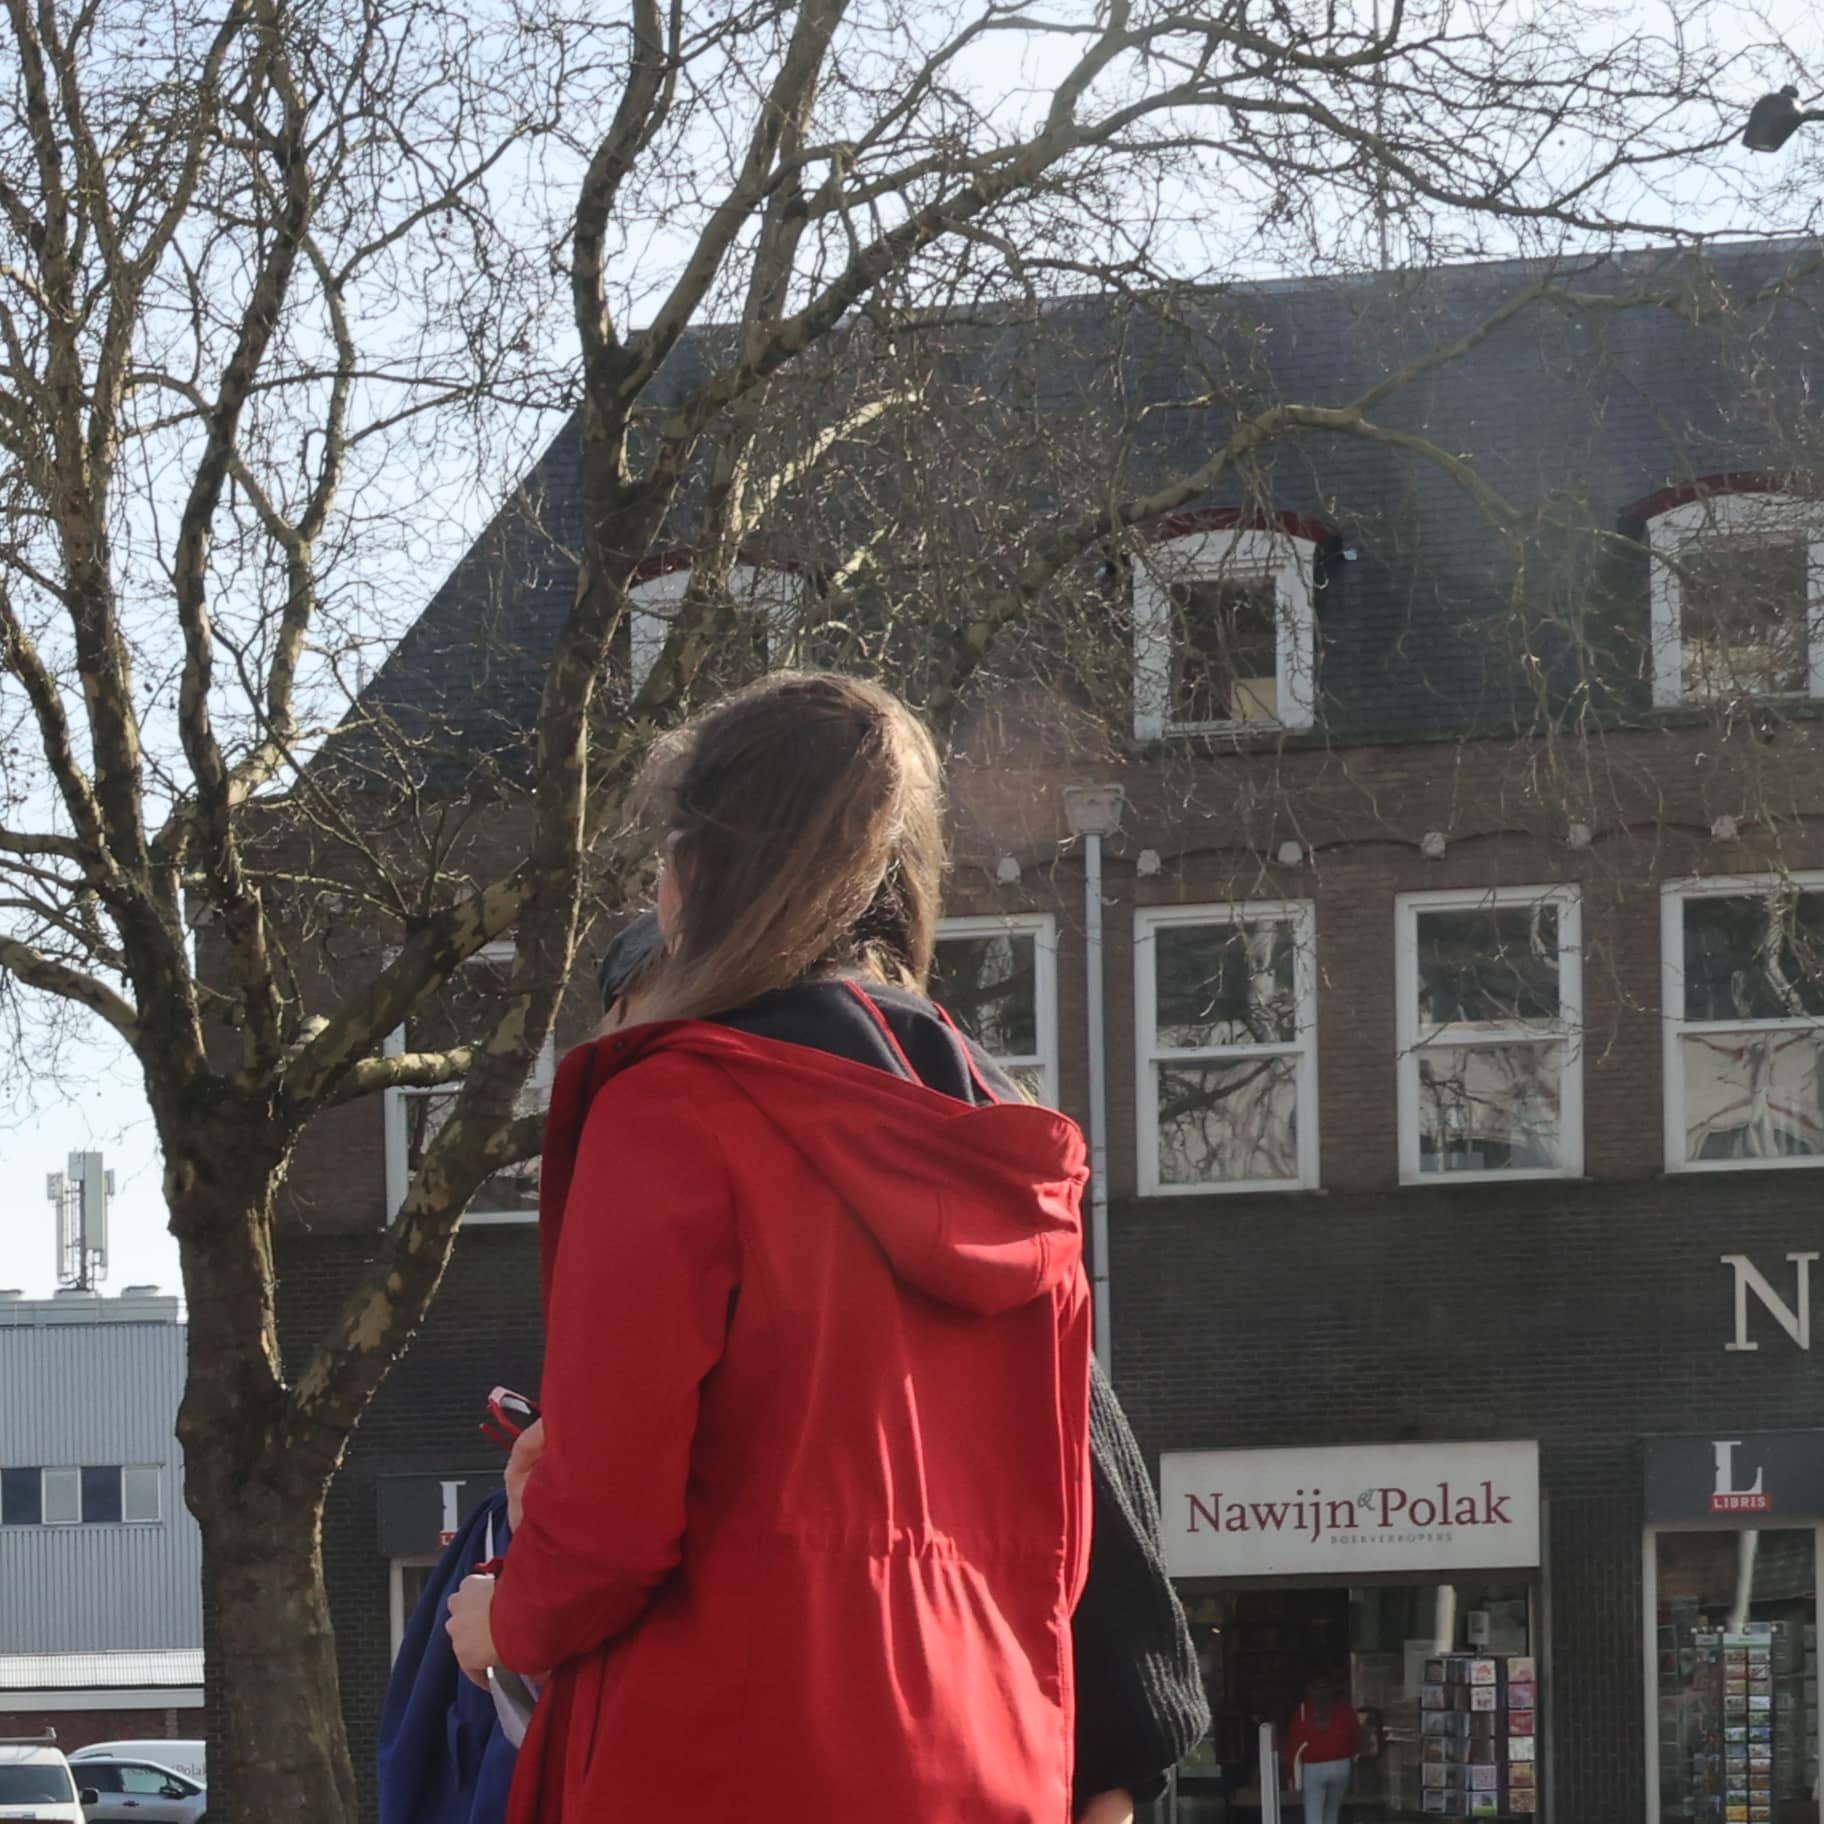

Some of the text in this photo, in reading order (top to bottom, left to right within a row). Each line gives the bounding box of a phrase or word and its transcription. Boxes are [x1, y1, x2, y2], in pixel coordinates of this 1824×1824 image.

[1712, 1441, 1762, 1495] L
[1185, 1489, 1359, 1542] Nawijn
[1377, 1481, 1512, 1527] Polak
[1714, 1497, 1766, 1509] LIBRIS
